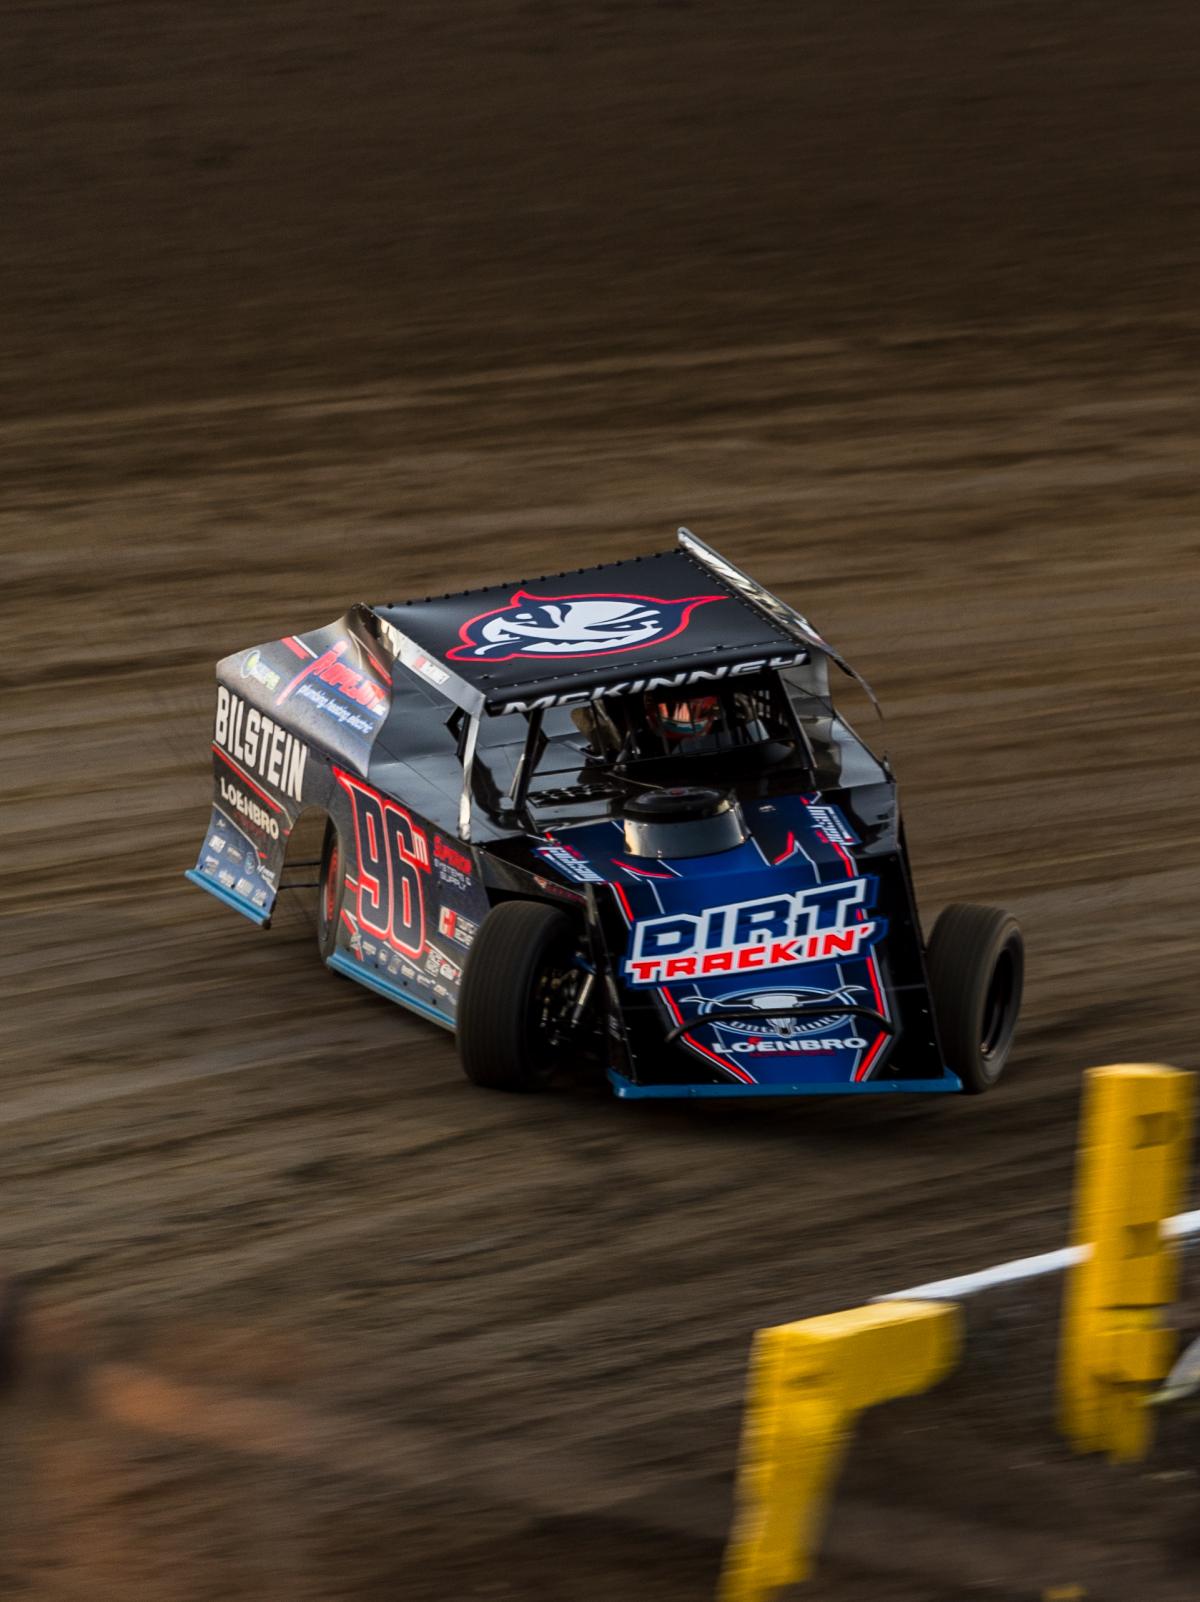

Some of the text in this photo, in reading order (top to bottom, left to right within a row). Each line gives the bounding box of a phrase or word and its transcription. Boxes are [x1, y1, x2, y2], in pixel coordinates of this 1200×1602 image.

[215, 686, 308, 802] BILSTEIN
[220, 776, 280, 840] LOENBRO
[634, 878, 868, 958] DIRT
[628, 924, 873, 982] TRACKIN'
[711, 1037, 869, 1054] LOENBRO
